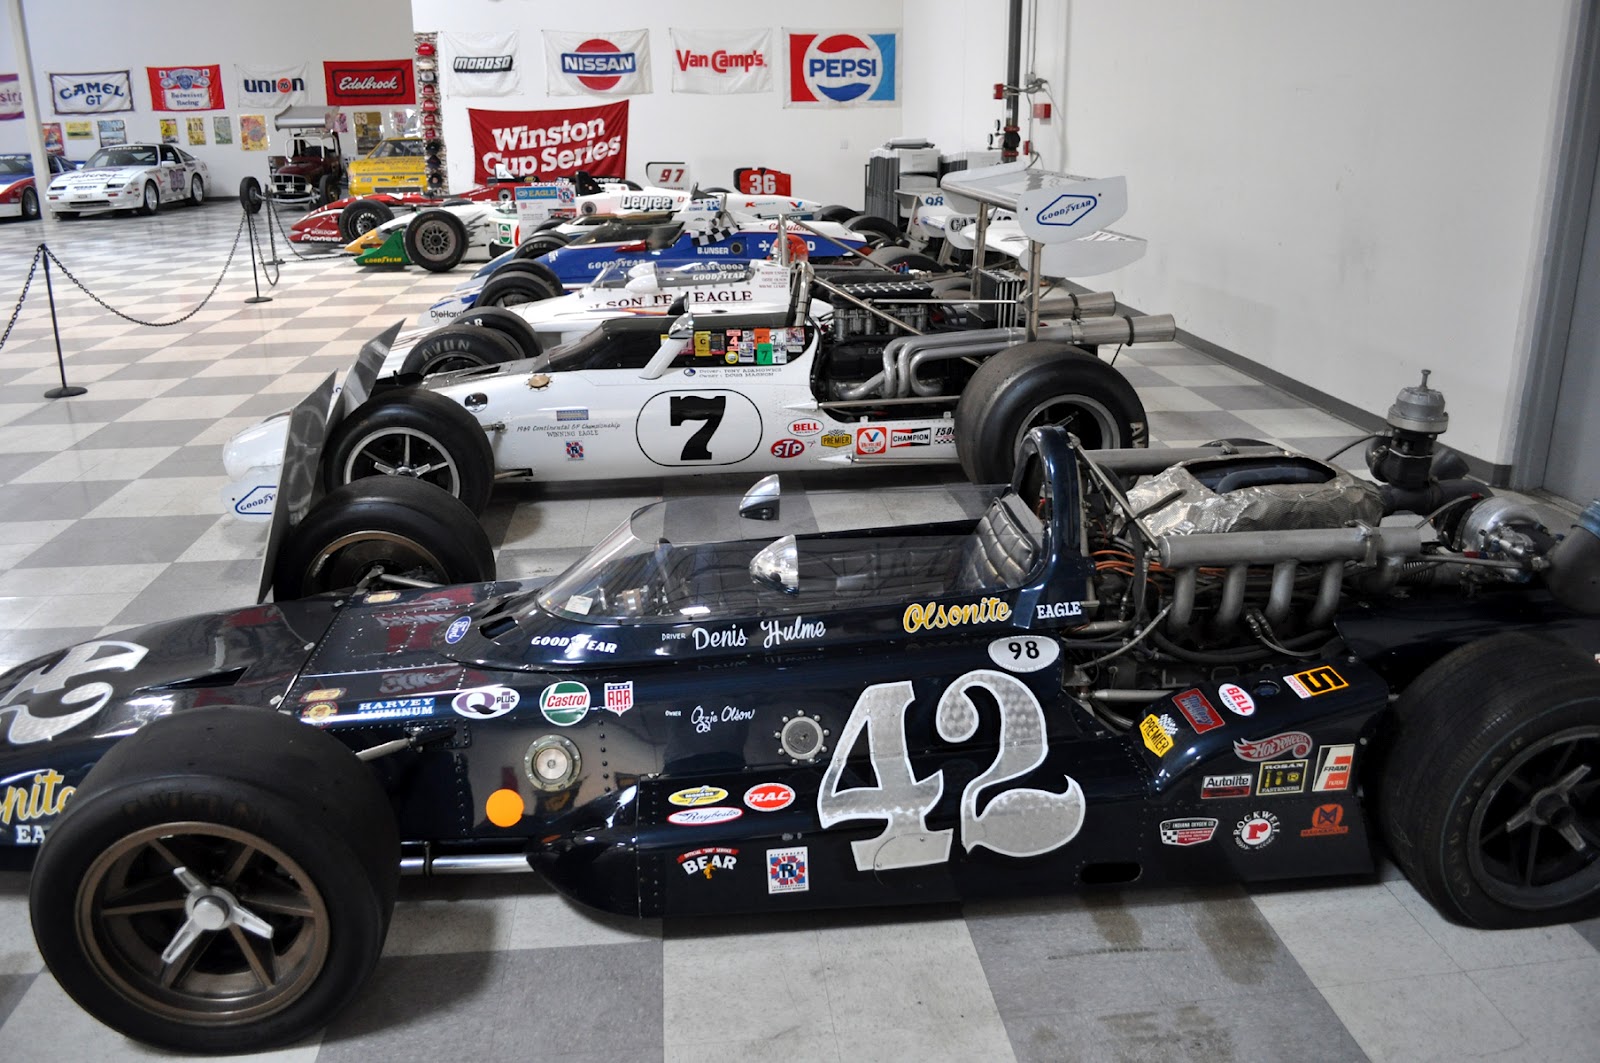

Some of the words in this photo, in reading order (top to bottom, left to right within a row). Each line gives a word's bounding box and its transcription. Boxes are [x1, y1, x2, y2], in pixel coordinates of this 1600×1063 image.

[454, 56, 512, 73] MOROSO
[564, 53, 635, 74] NISSAN
[676, 49, 708, 72] Van
[710, 48, 763, 74] Camp's
[809, 57, 877, 78] PEPSI
[60, 82, 124, 100] CAMEL
[339, 76, 398, 91] Edelbrock
[86, 95, 102, 106] GT
[354, 113, 368, 124] 63
[492, 114, 605, 152] Winston
[482, 149, 538, 177] Cup
[541, 134, 622, 173] Series
[659, 168, 685, 183] 97
[750, 174, 776, 194] 36
[528, 188, 556, 198] EAGLE
[621, 194, 673, 212] Degree
[1041, 200, 1092, 222] GOODYEAR
[301, 234, 343, 242] Pioneer
[697, 246, 729, 254] B.UNSER
[692, 272, 746, 281] GOODYEAR
[694, 290, 753, 302] EAGLE
[730, 336, 738, 346] 4
[761, 350, 768, 362] 7
[670, 395, 726, 461] 7
[792, 422, 819, 432] BELL
[823, 436, 850, 445] PREMIER
[892, 434, 930, 442] CHAMPION
[774, 440, 804, 457] STP
[240, 492, 276, 511] GOODY
[903, 596, 1012, 634] Olsonite
[1036, 601, 1082, 620] EAGLE
[662, 633, 686, 641] DRIVER
[692, 624, 749, 650] Denis
[760, 616, 826, 648] Hulme
[1008, 640, 1040, 660] 98
[359, 698, 435, 710] HARVEY
[456, 691, 499, 715] Q
[496, 695, 516, 704] PLUS
[546, 693, 588, 708] Castrol
[607, 690, 630, 706] AAR
[1226, 686, 1254, 714] BELL
[358, 706, 434, 716] ALUMINUM
[720, 705, 755, 722] Olson
[1142, 717, 1170, 753] PREMIER
[817, 669, 1086, 872] 42
[1206, 776, 1249, 788] Autolite
[750, 791, 790, 803] RAC
[680, 810, 740, 823] Raybestos
[682, 854, 738, 876] BEAR
[782, 863, 796, 878] R
